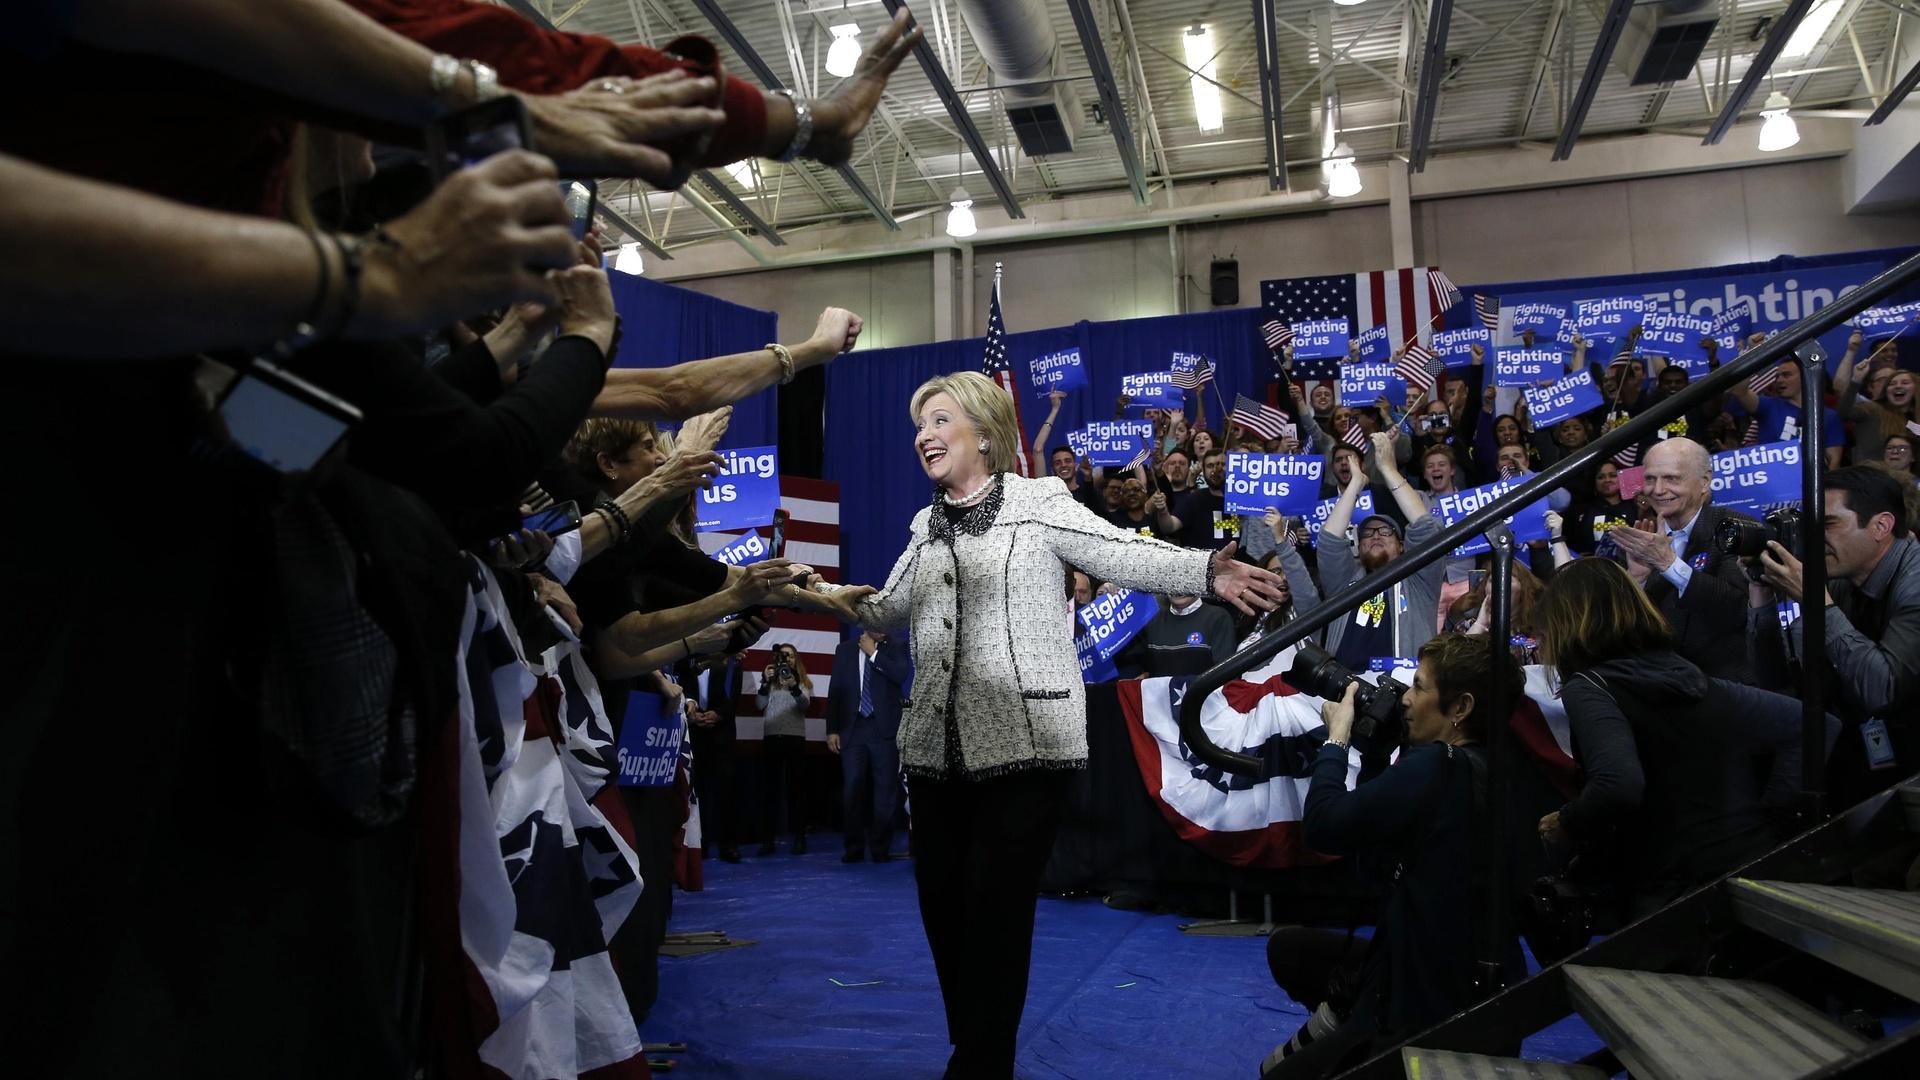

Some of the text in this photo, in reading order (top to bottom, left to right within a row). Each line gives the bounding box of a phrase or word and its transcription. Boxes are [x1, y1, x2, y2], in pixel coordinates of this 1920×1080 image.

[1515, 303, 1566, 319] Fighting
[1579, 297, 1643, 315] Fighting
[1291, 320, 1348, 337] Fighting
[1513, 314, 1544, 326] for us
[1577, 313, 1622, 328] for us
[1641, 313, 1713, 335] Fighting
[1854, 315, 1905, 328] for us
[1291, 335, 1330, 348] for us
[1360, 327, 1387, 345] hting
[1432, 328, 1489, 346] Fighting
[1664, 331, 1685, 343] us
[1361, 345, 1375, 355] us
[1455, 344, 1471, 354] us
[1497, 349, 1562, 364] Fighting
[1029, 351, 1081, 374] Fighting
[1497, 362, 1541, 375] for us
[1031, 369, 1064, 387] for us
[1123, 372, 1172, 389] Fightin
[1341, 379, 1386, 393] for us
[1524, 370, 1591, 403] Fighting
[1122, 385, 1162, 397] for us
[1528, 393, 1574, 416] for us
[1087, 421, 1152, 440] Fighting
[1087, 437, 1109, 452] for
[1112, 439, 1131, 451] us
[719, 451, 775, 478] ting
[1228, 454, 1322, 481] Fighting
[1712, 446, 1799, 475] ighting
[1226, 473, 1290, 496] for us
[1710, 470, 1768, 491] or us
[703, 484, 737, 503] us
[718, 535, 764, 565] ting
[1090, 618, 1115, 643] for
[1117, 602, 1134, 624] us
[645, 726, 667, 747] us
[618, 748, 678, 784] Fighting
